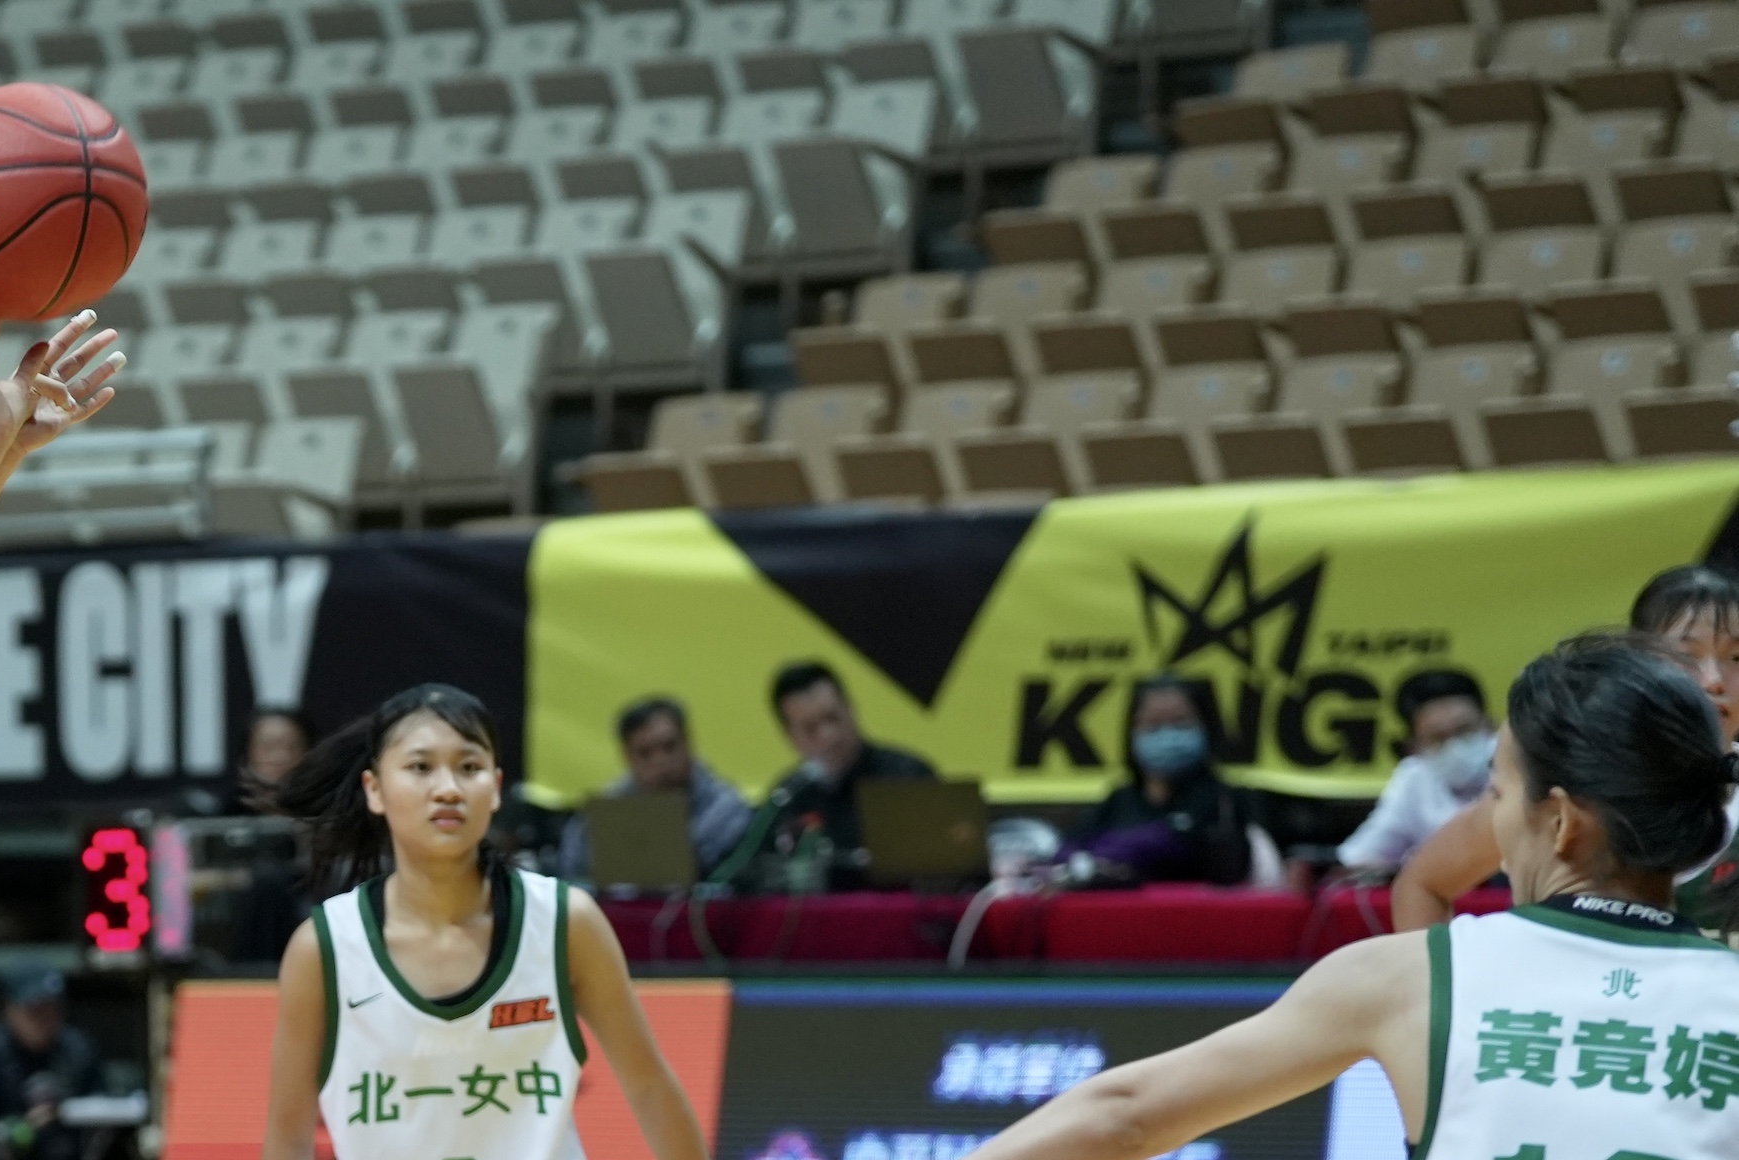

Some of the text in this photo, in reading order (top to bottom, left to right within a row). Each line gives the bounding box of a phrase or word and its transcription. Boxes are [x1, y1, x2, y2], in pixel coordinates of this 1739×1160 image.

[56, 557, 332, 782] CITY
[81, 828, 151, 953] 3
[1572, 896, 1675, 926] NIKE PRO
[348, 1060, 562, 1125] 北一女中
[1474, 1008, 1739, 1112] 黃竟婷
